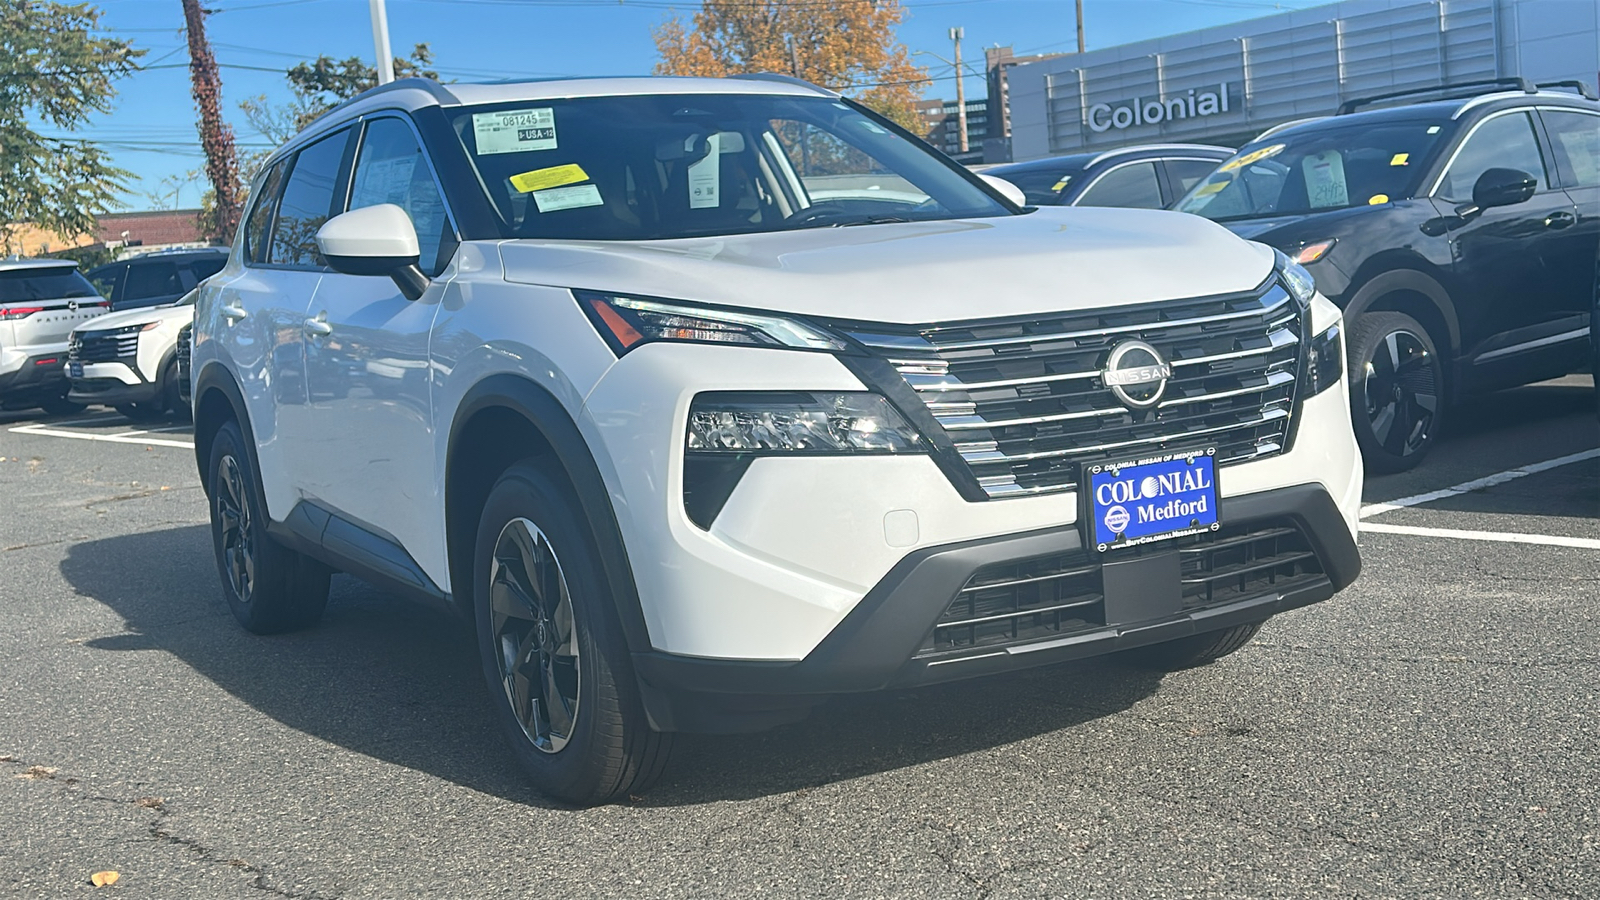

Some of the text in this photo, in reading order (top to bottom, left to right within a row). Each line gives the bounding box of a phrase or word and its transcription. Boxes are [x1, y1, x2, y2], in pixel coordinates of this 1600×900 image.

[1088, 82, 1229, 132] Colonial
[502, 114, 538, 127] 081245
[525, 129, 543, 139] USA
[1108, 366, 1171, 384] NISSAN
[1104, 450, 1204, 471] COLONIAL NISSAN OF MEDFORD
[1096, 468, 1210, 506] COLONIAL
[1137, 495, 1208, 523] Medford
